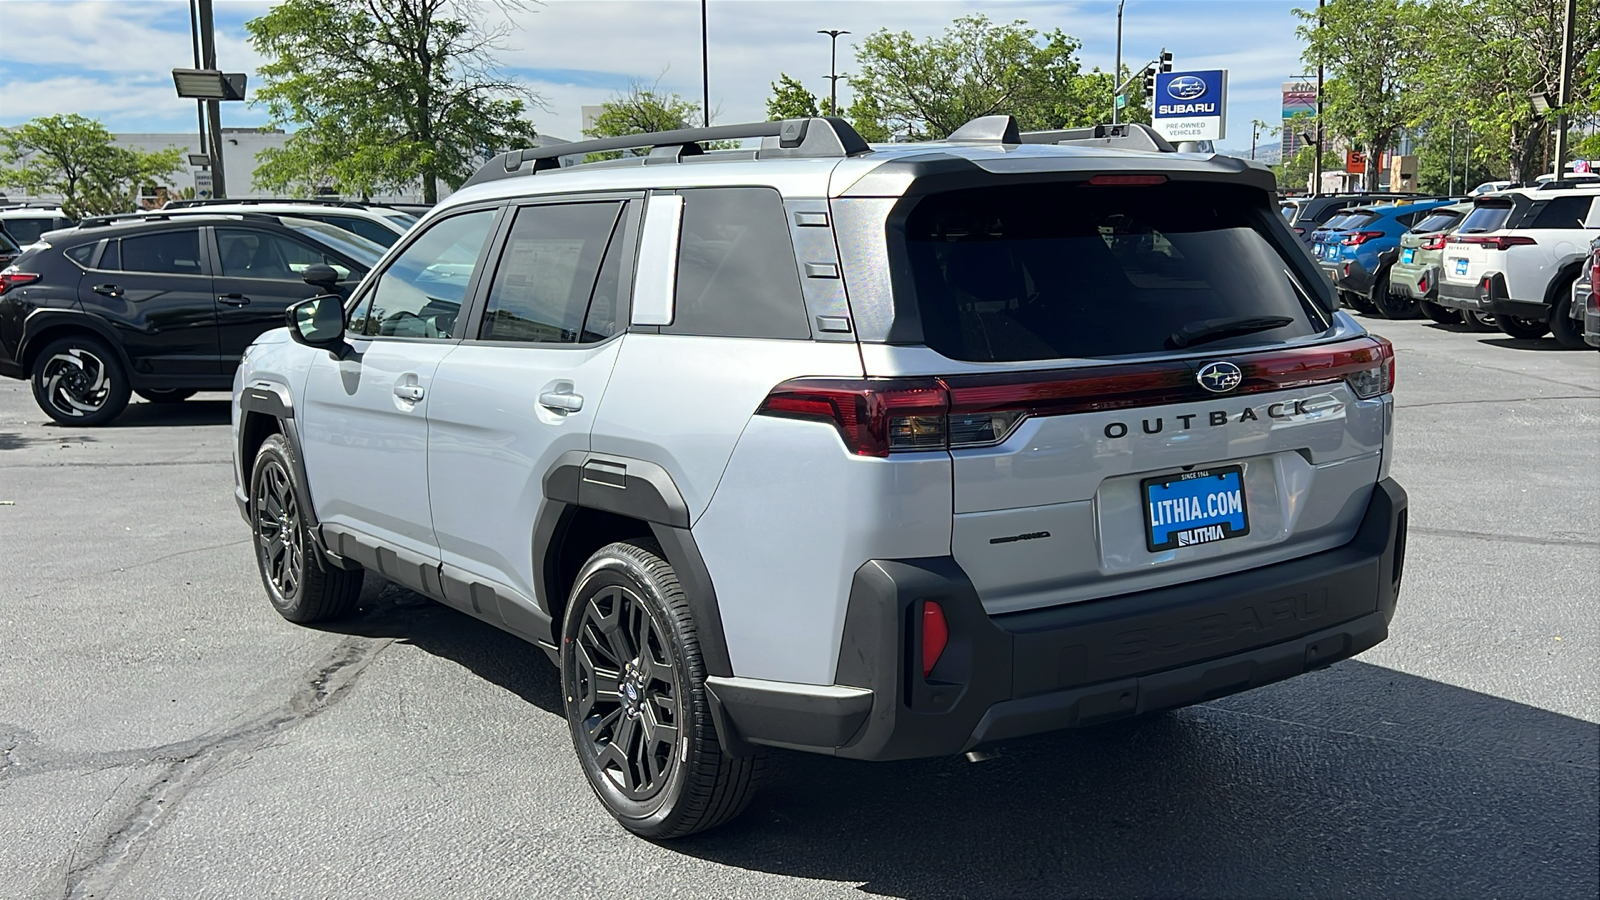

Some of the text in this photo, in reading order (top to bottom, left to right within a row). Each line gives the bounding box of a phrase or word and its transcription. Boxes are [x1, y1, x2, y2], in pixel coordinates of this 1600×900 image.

[1158, 102, 1215, 115] SUBARU
[1103, 400, 1310, 439] OUTBACK
[1181, 472, 1197, 481] SINCE
[1149, 489, 1243, 527] LITHIA.COM
[1189, 525, 1225, 545] LITHIA
[1107, 587, 1329, 662] SUBARU
